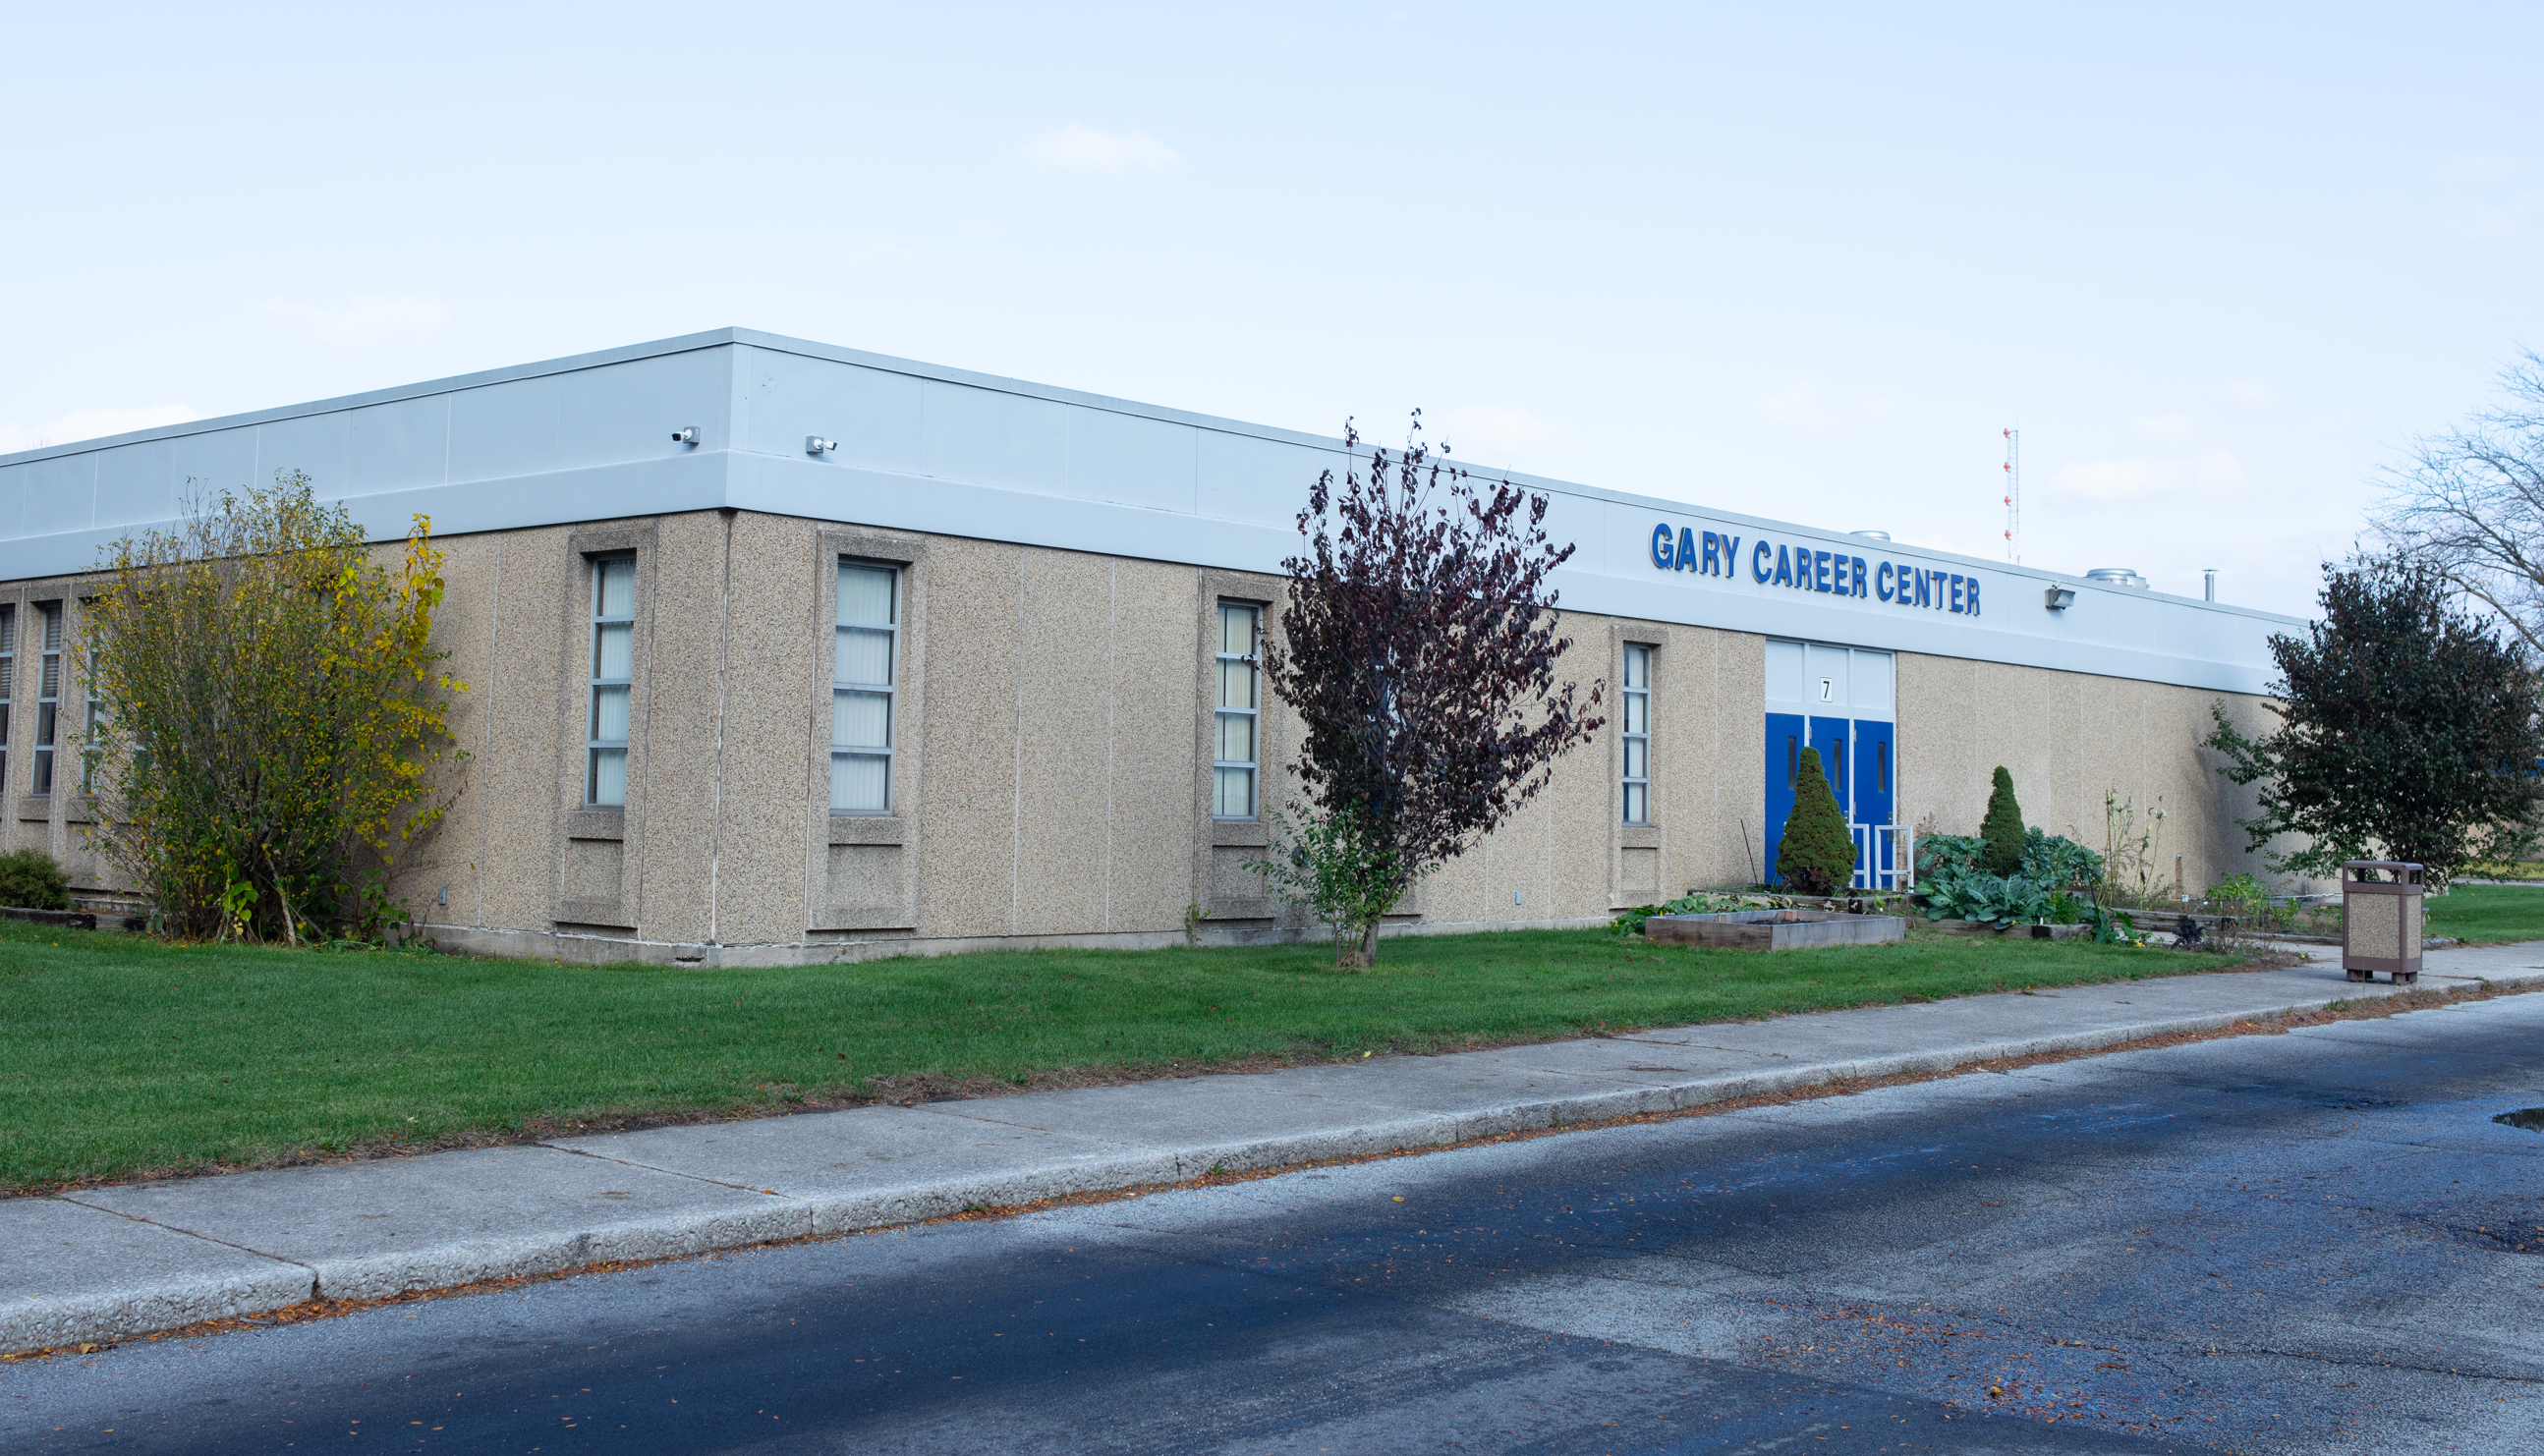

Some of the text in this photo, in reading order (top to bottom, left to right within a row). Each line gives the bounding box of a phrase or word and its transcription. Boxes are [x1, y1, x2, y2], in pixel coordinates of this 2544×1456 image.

[1650, 523, 1980, 615] GARY CAREER CENTER
[1823, 680, 1830, 699] 7
